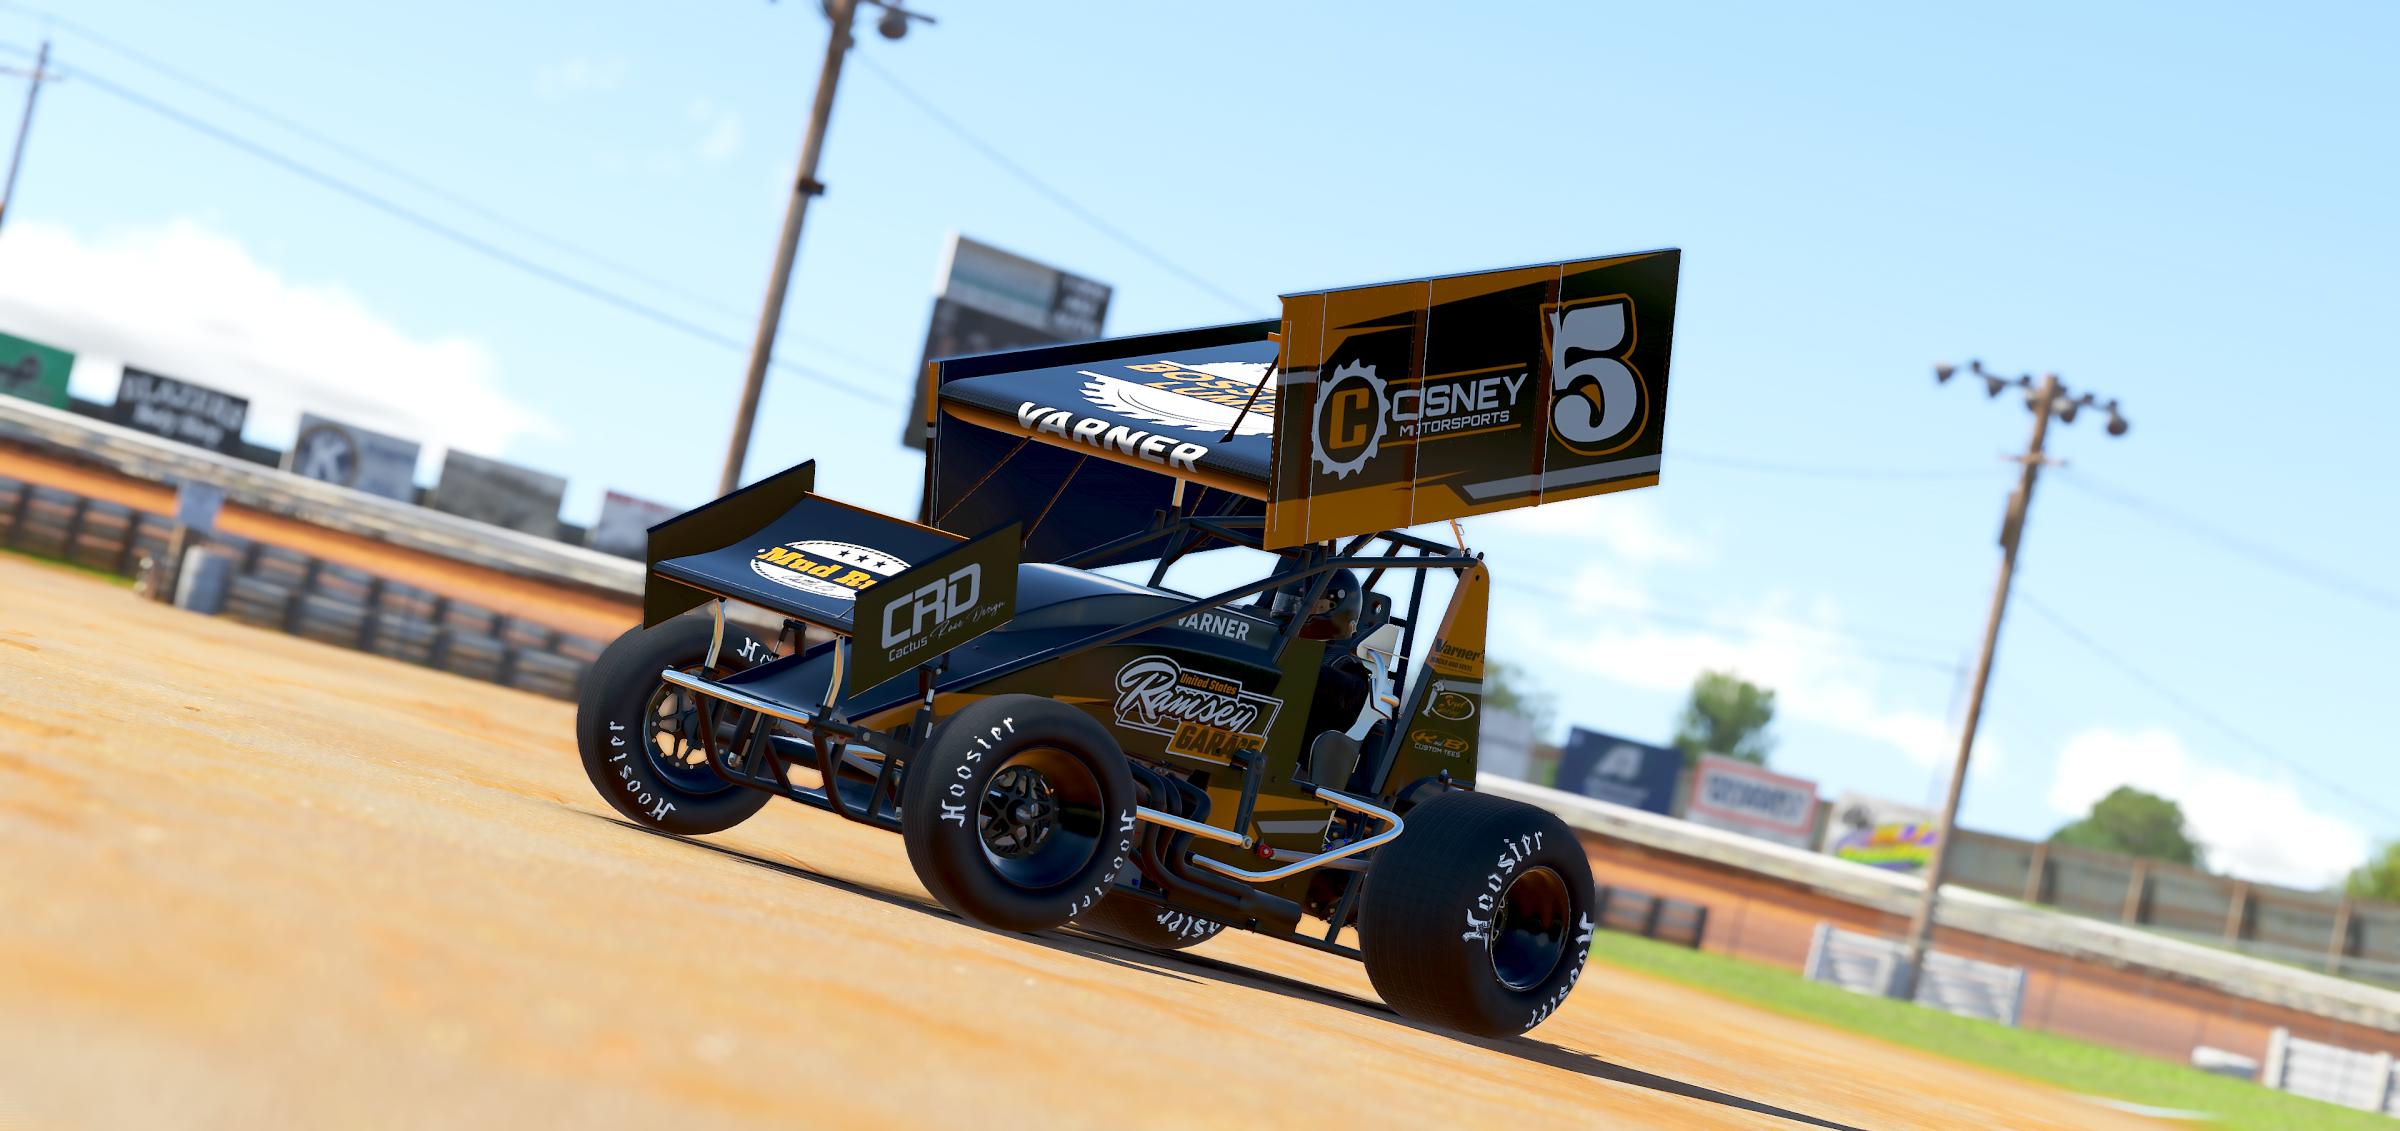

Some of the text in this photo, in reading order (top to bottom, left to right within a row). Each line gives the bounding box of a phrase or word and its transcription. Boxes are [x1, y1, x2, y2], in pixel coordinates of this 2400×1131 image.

[1547, 303, 1638, 443] 5
[1017, 401, 1209, 473] VARNER
[1329, 387, 1370, 449] C
[755, 547, 843, 578] Mud
[881, 563, 982, 649] CRD
[888, 636, 928, 662] Cactus
[1179, 672, 1238, 696] United States
[1120, 661, 1253, 730] Ramsey
[609, 720, 677, 821] Hoosier
[939, 715, 1015, 828] Hoosier
[1461, 829, 1544, 952] Hoosier
